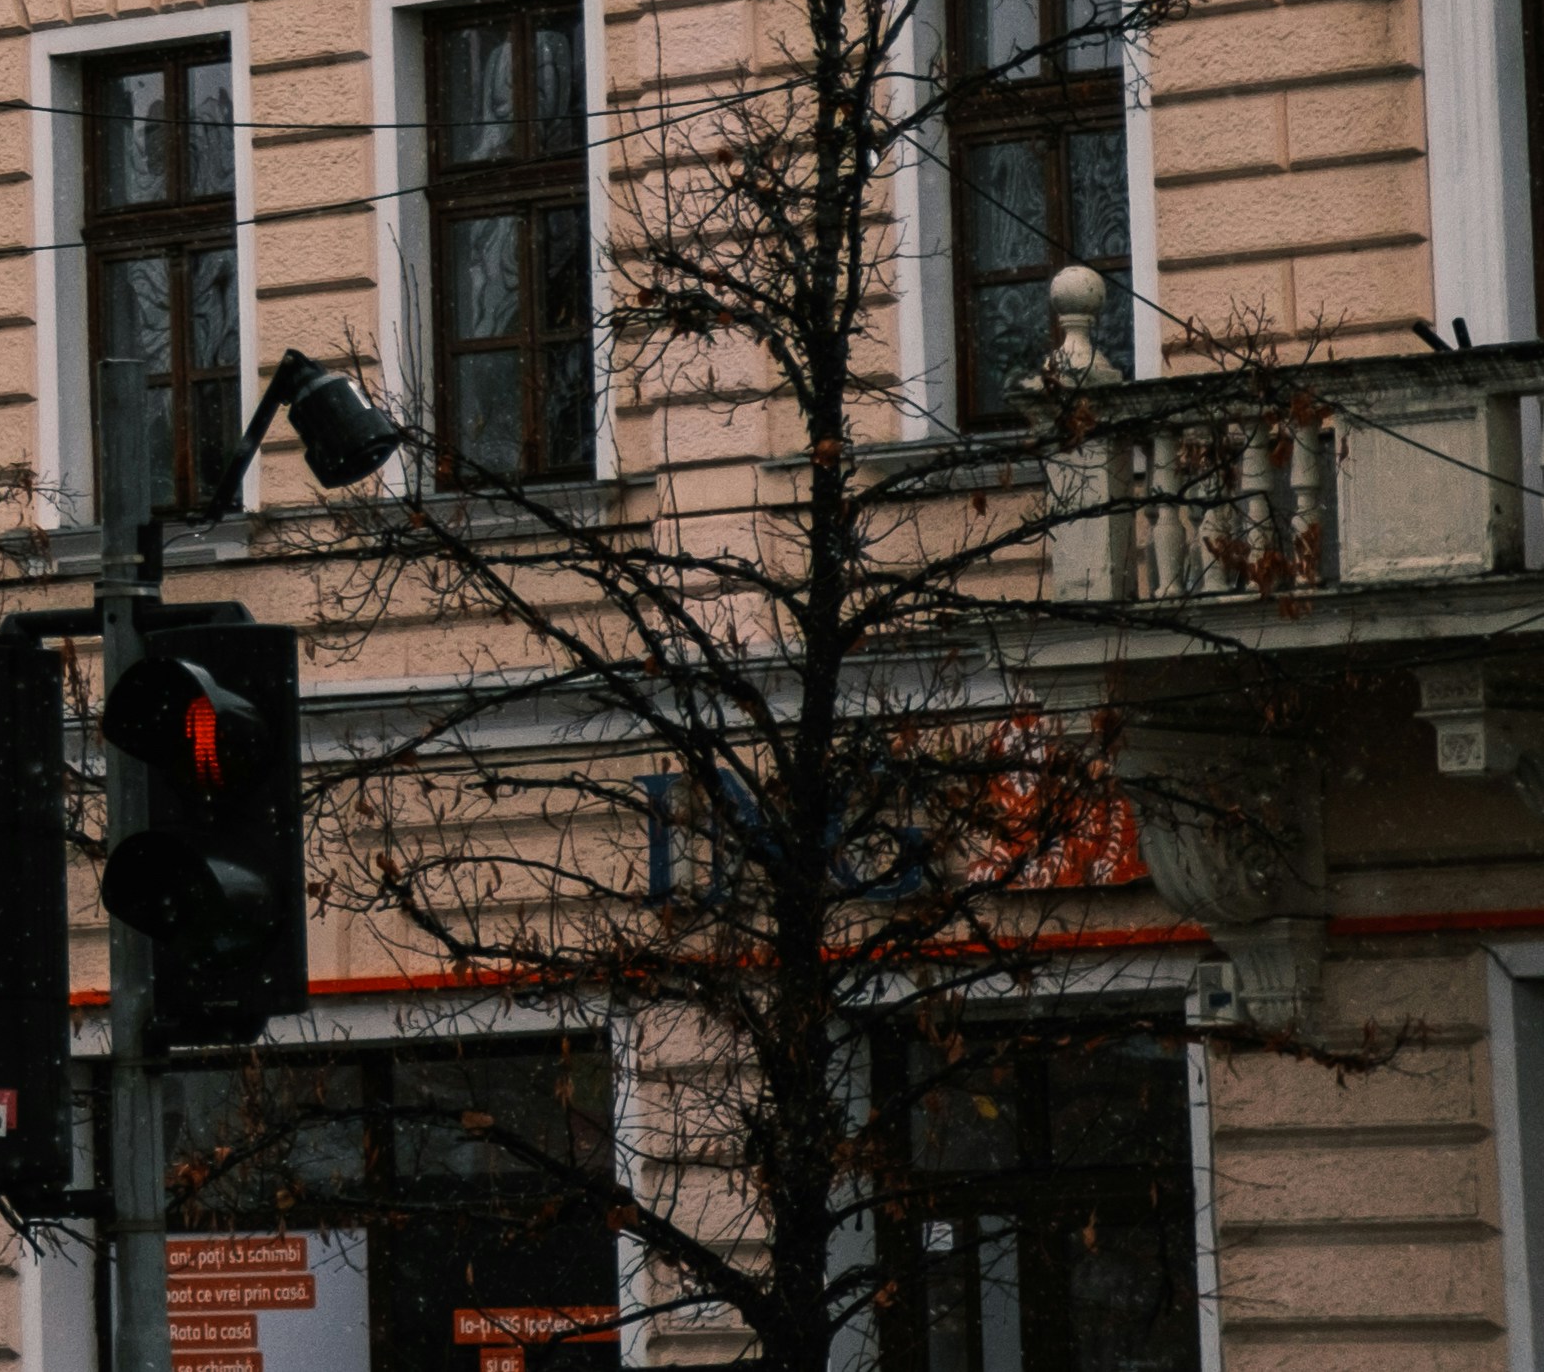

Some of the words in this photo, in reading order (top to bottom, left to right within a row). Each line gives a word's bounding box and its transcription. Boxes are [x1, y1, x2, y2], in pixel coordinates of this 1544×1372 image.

[247, 1242, 301, 1263] schimbi
[196, 1289, 213, 1304] ce
[215, 1283, 241, 1303] vrei
[244, 1283, 271, 1306] prin
[170, 1323, 201, 1342] Rata
[220, 1321, 252, 1340] casă
